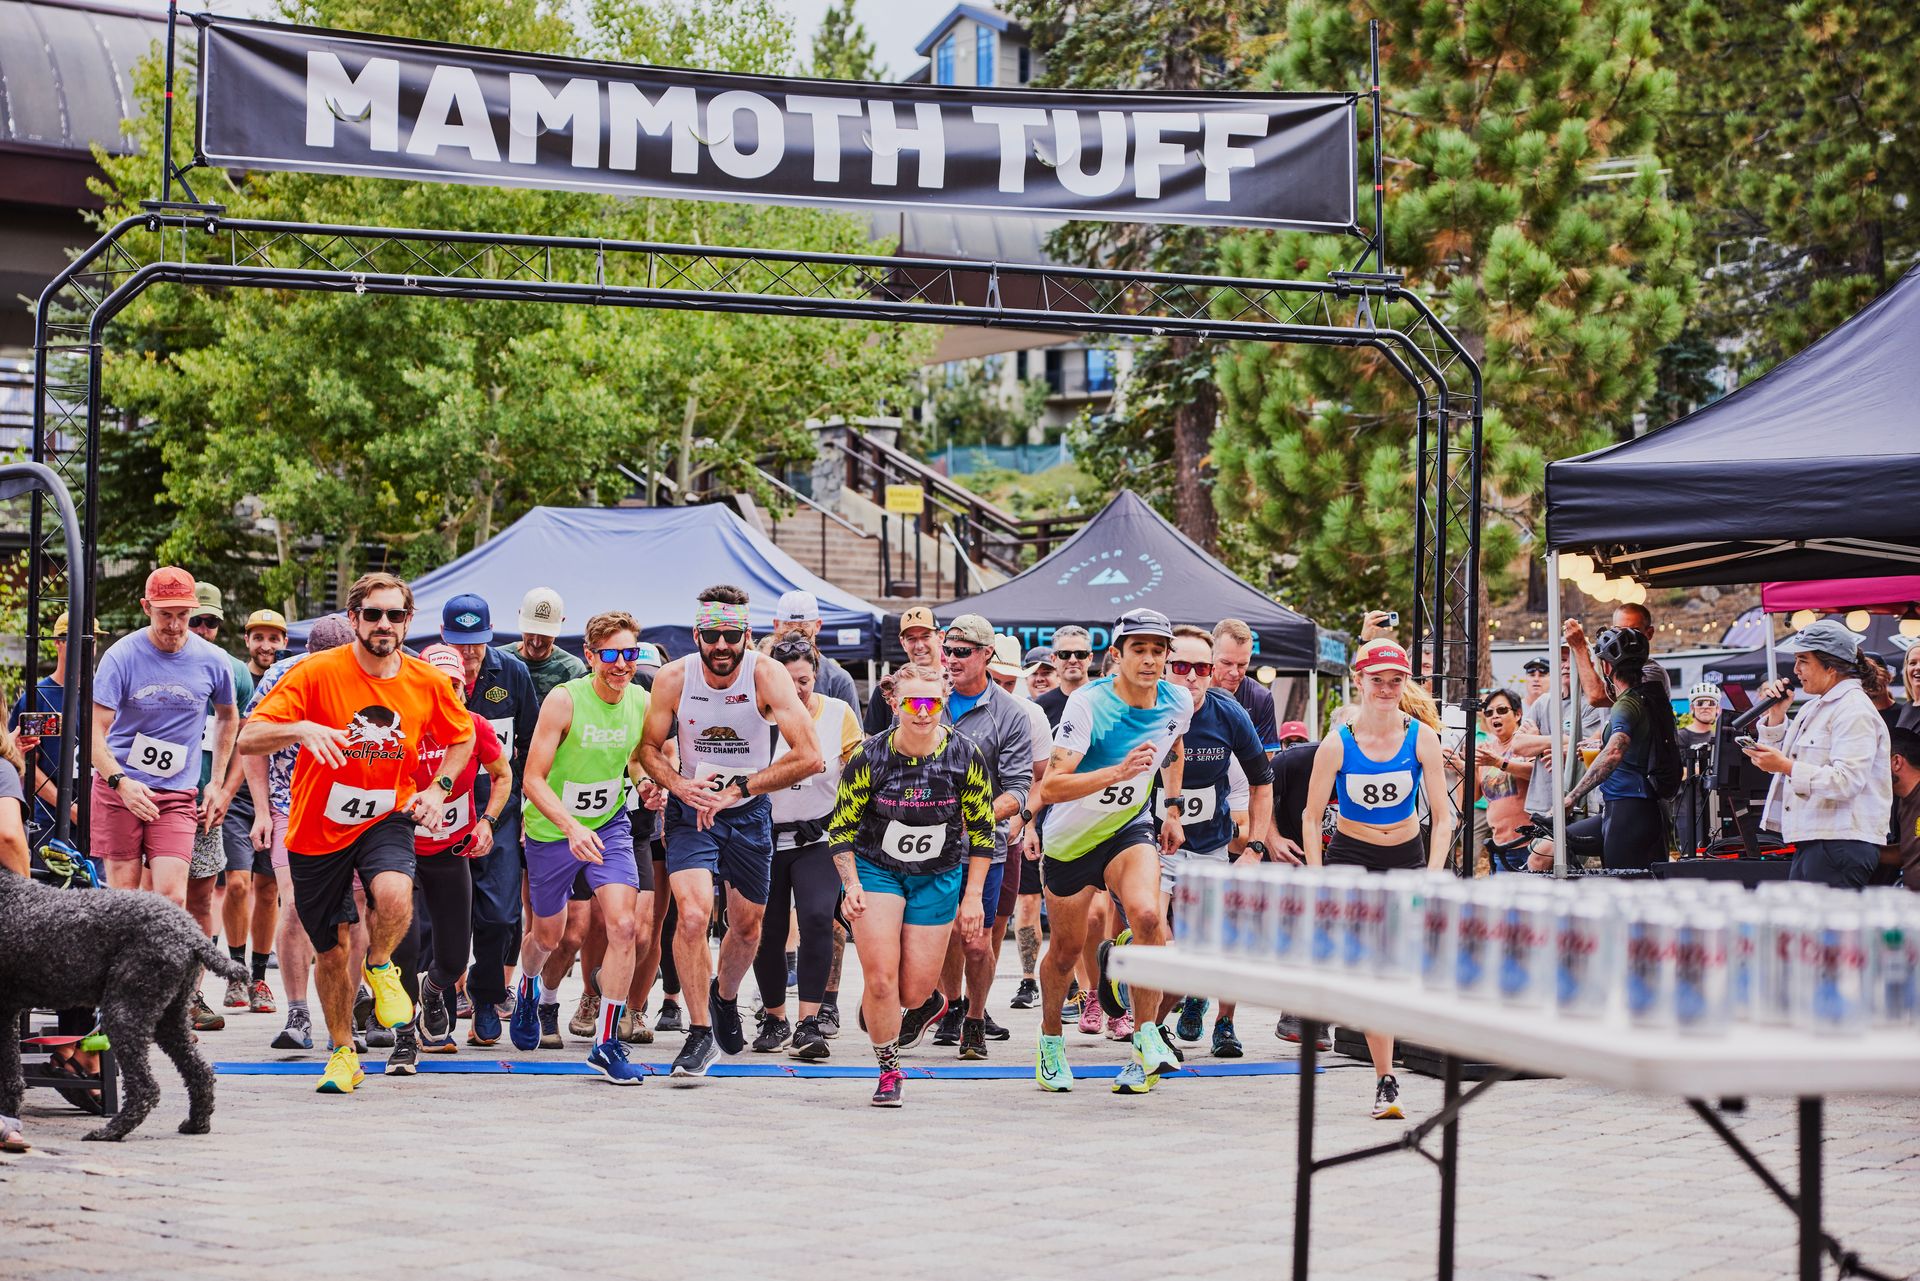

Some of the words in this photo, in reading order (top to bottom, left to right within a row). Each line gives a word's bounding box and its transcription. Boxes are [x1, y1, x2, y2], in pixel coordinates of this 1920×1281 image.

[305, 50, 945, 189] MAMMOTH
[971, 105, 1270, 202] TUFF
[1057, 549, 1123, 585] SHELTER
[1110, 553, 1164, 604] DISTILLING
[1378, 650, 1399, 658] cielo
[141, 746, 174, 770] 98
[342, 743, 406, 766] wolfpack
[694, 745, 712, 753] 2023
[713, 746, 750, 754] CHAMPION
[1196, 746, 1225, 754] STATES
[1196, 754, 1225, 762] SERVICE
[575, 789, 608, 810] 55
[899, 800, 936, 808] PROGRAM
[1099, 786, 1135, 806] 58
[1363, 783, 1399, 805] 88
[340, 798, 377, 819] 41
[897, 834, 933, 854] 66
